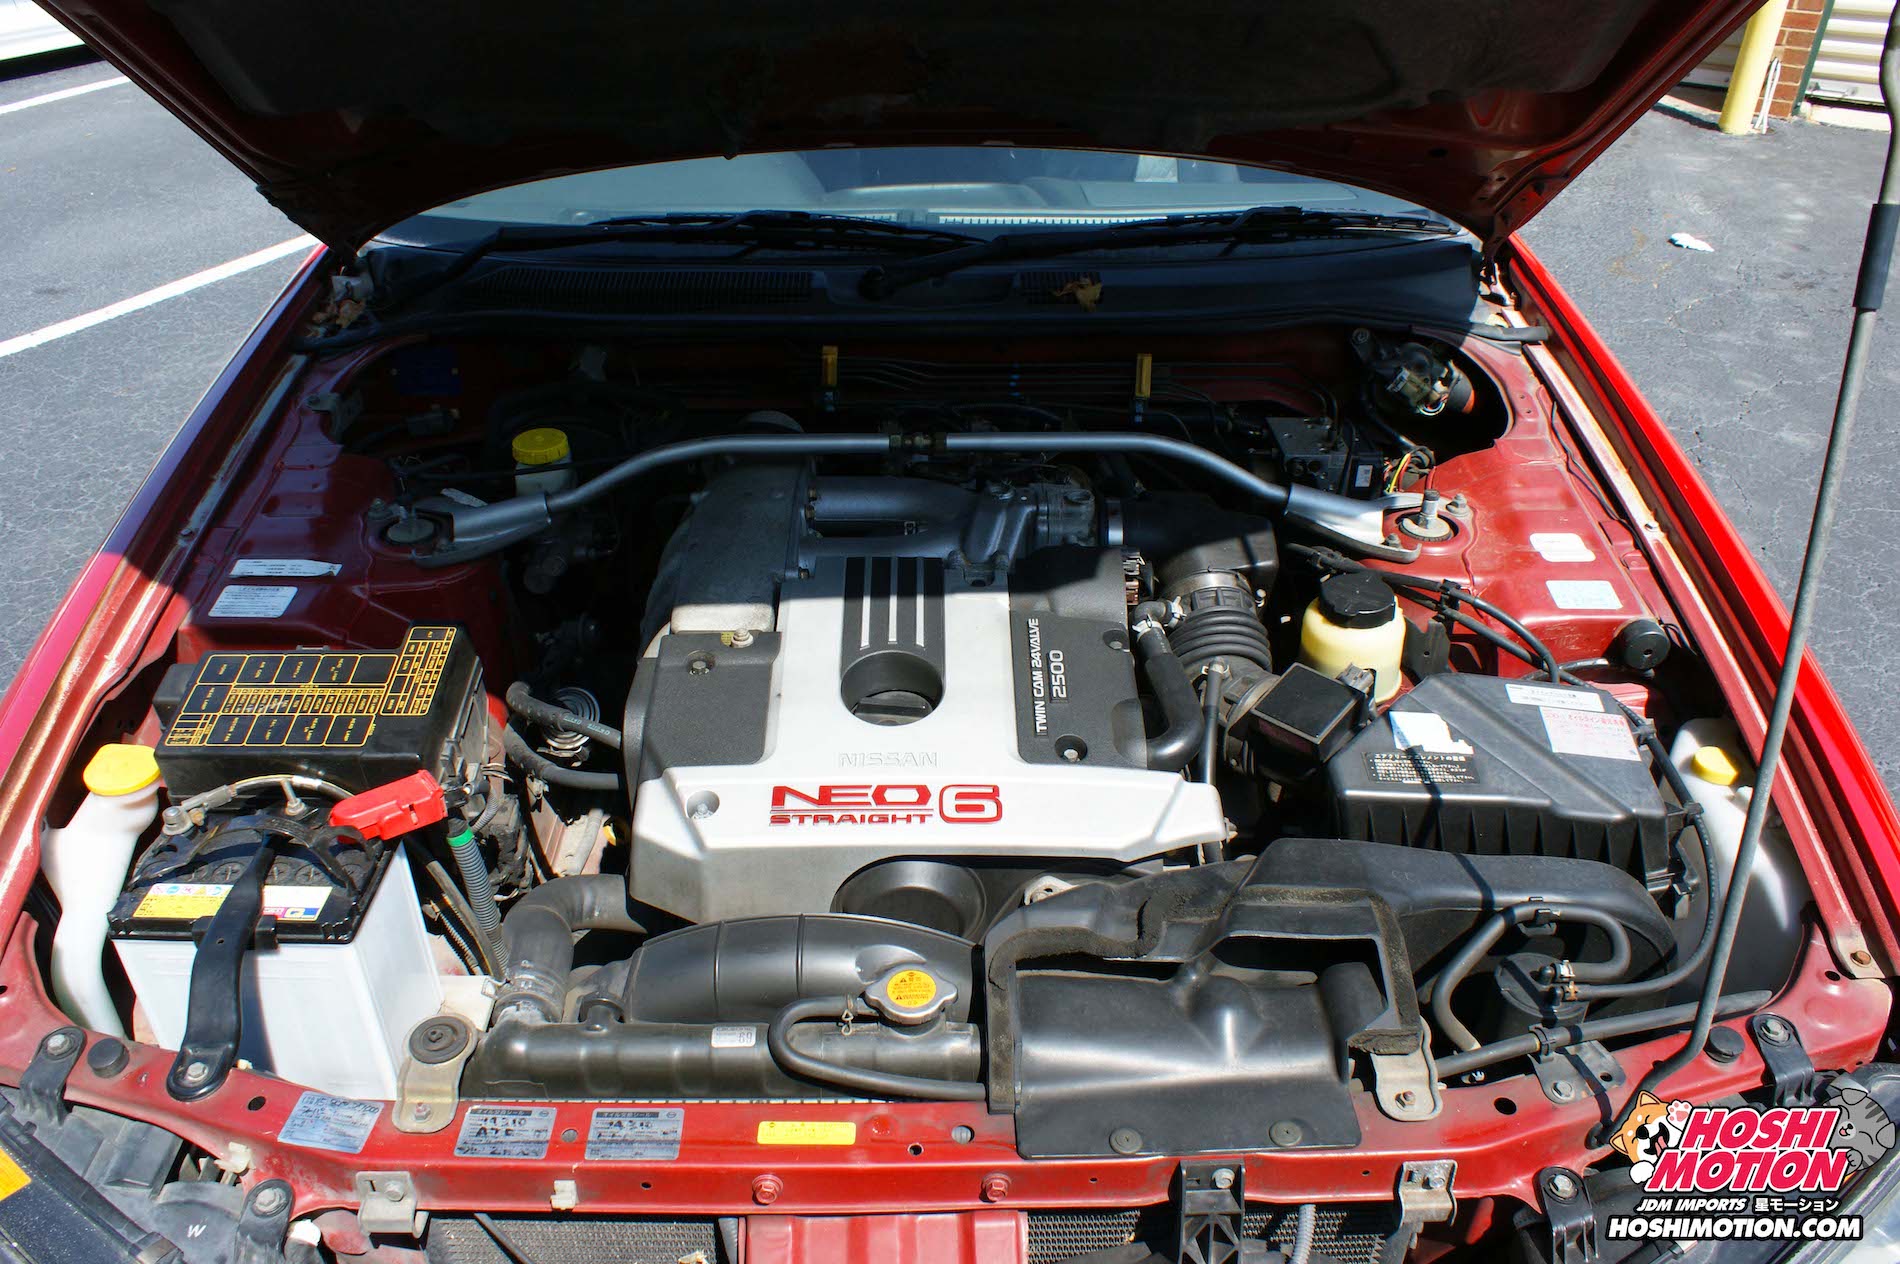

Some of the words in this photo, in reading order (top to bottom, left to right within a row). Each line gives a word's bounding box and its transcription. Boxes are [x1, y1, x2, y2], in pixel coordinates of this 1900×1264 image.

[1028, 618, 1042, 668] 24VALVE
[1032, 671, 1044, 698] CAM
[1050, 650, 1067, 698] 2500
[1035, 701, 1047, 732] TWIN
[839, 752, 938, 768] NISSAN
[772, 785, 932, 808] NEO
[939, 784, 1002, 824] 6
[769, 814, 933, 826] STRAIGHT
